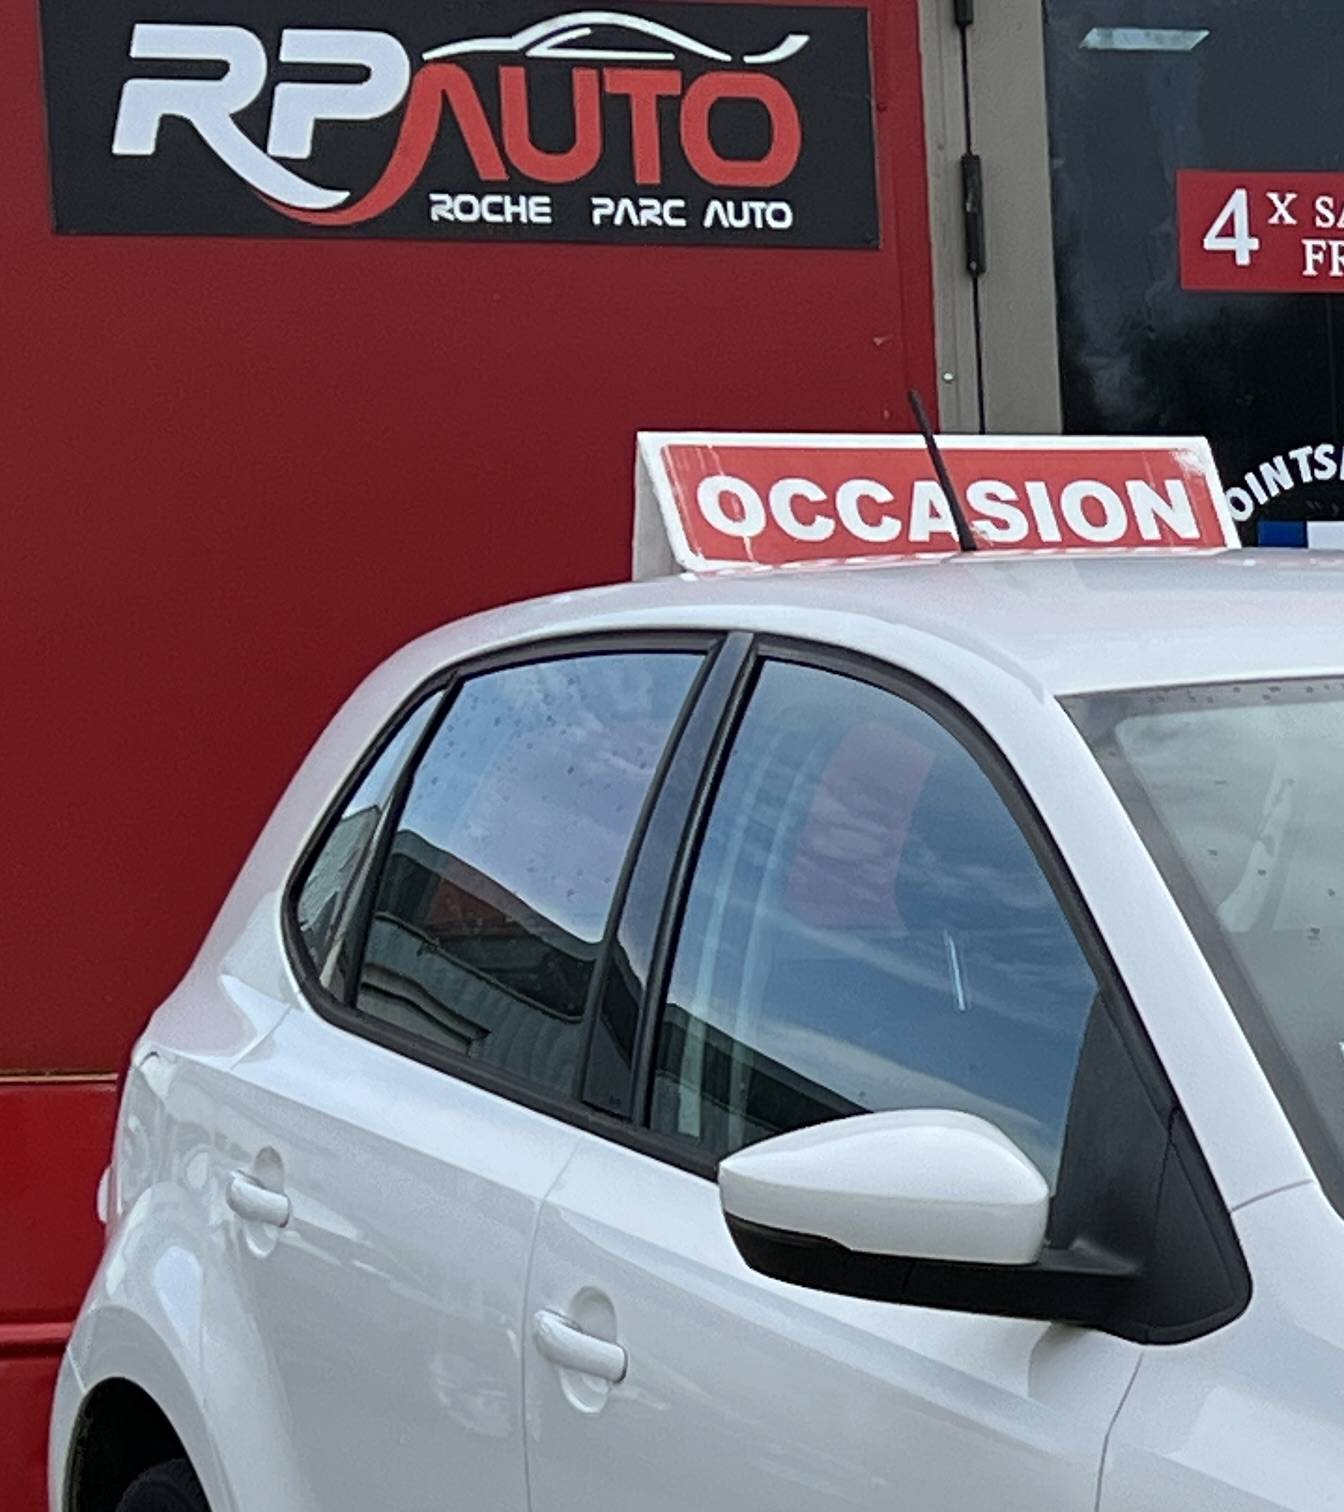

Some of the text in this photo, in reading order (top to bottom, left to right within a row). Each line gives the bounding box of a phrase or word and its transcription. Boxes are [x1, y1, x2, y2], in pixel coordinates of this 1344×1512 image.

[429, 193, 794, 231] ROCHE PARC AUTO
[697, 474, 1201, 544] OCCASION
